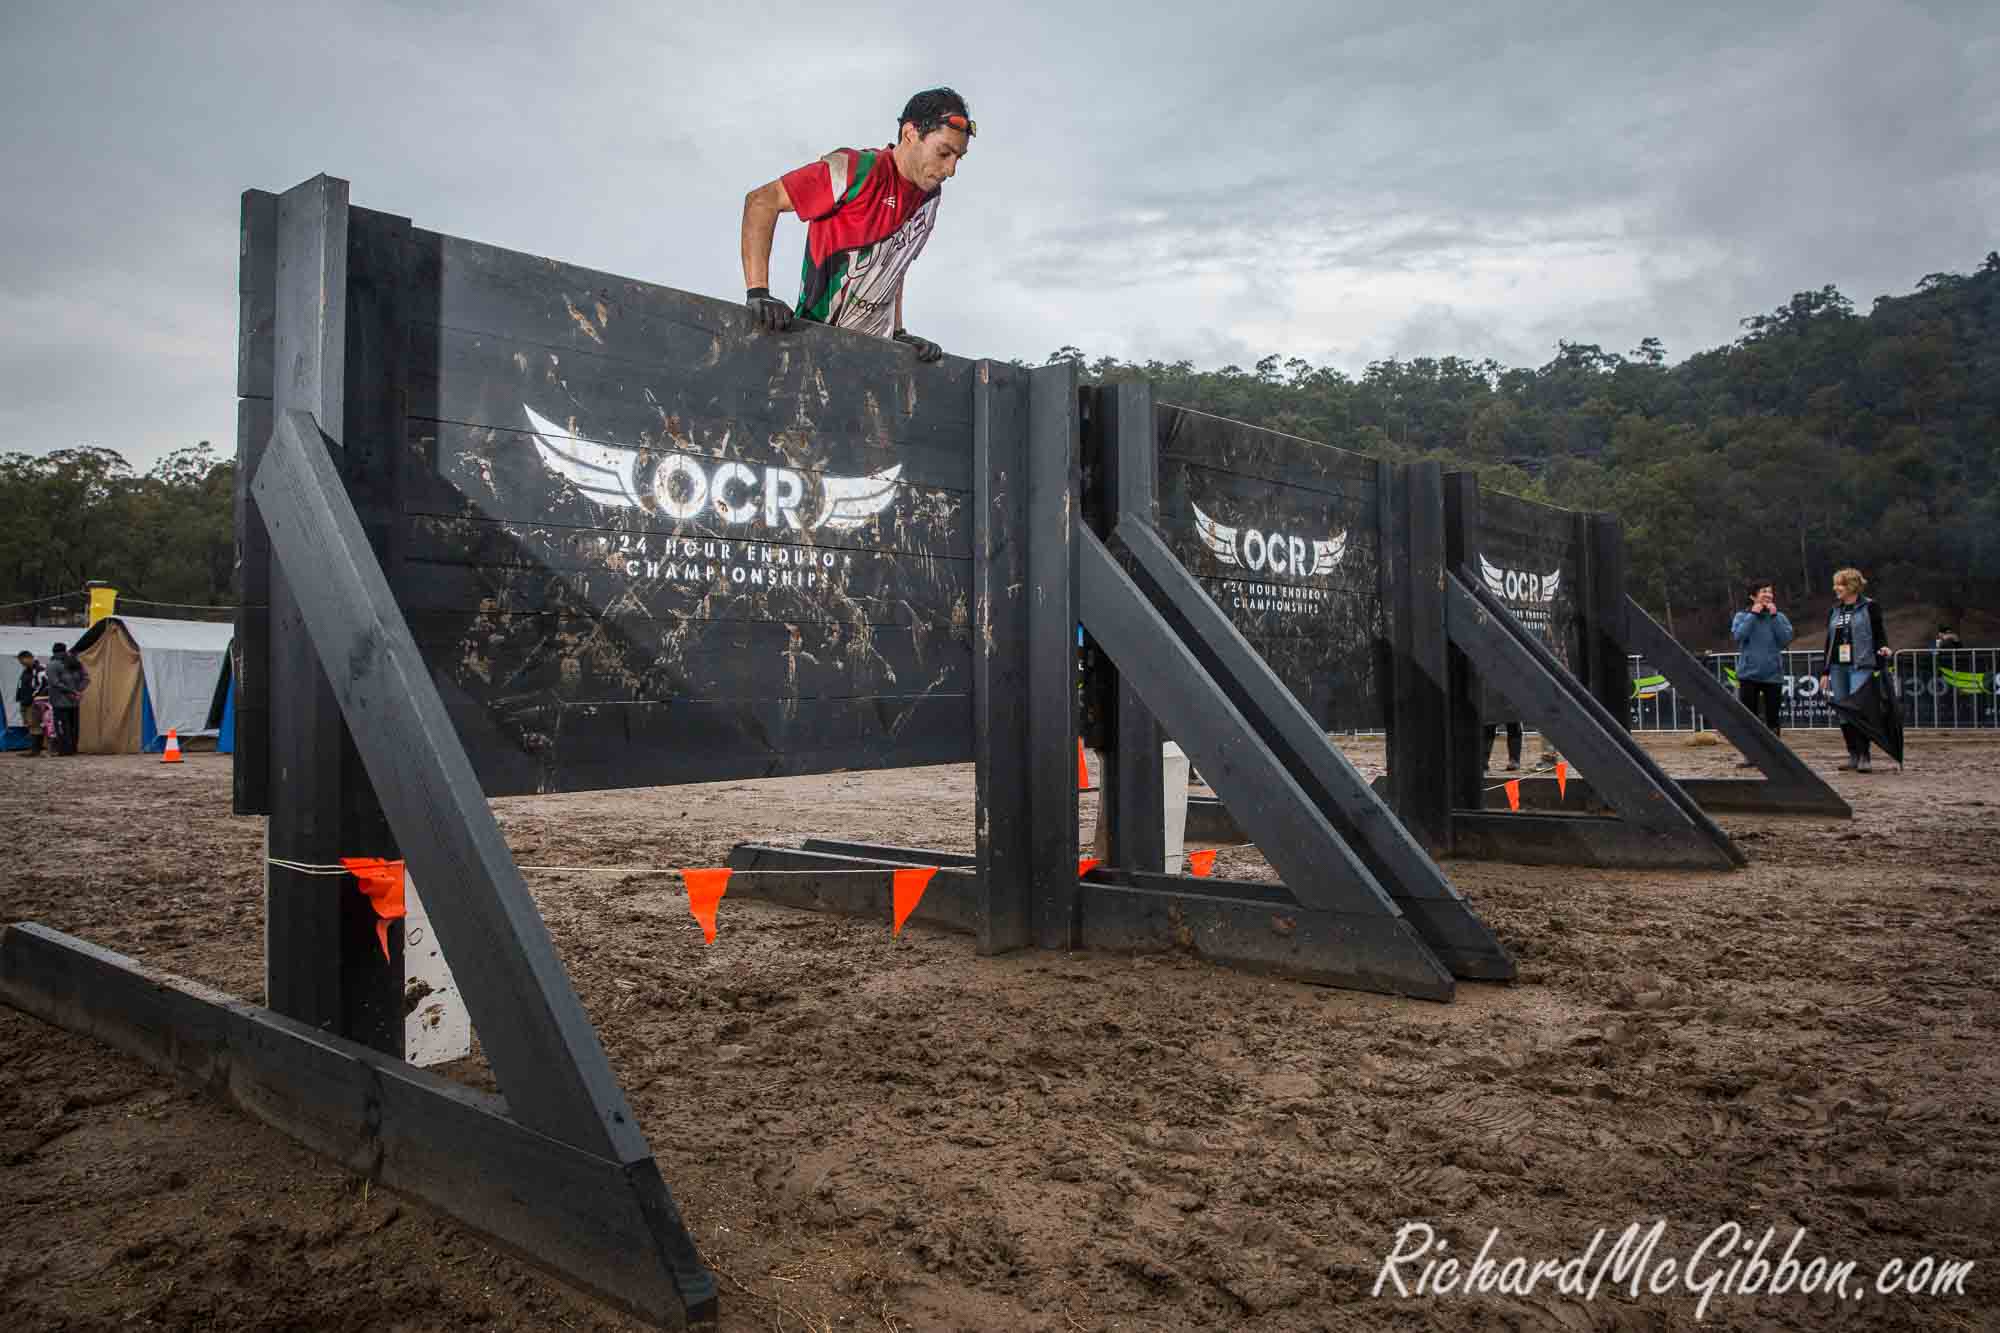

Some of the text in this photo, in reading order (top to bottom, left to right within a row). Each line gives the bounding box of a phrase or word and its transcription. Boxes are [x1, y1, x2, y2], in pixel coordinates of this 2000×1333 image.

[653, 454, 810, 529] OCR
[619, 534, 835, 568] 24 HOUR ENDURO
[1244, 528, 1307, 576] OCR
[626, 559, 830, 586] CHAMPIONSHIPS
[1505, 569, 1540, 602] OCR
[1249, 583, 1277, 597] HOUR
